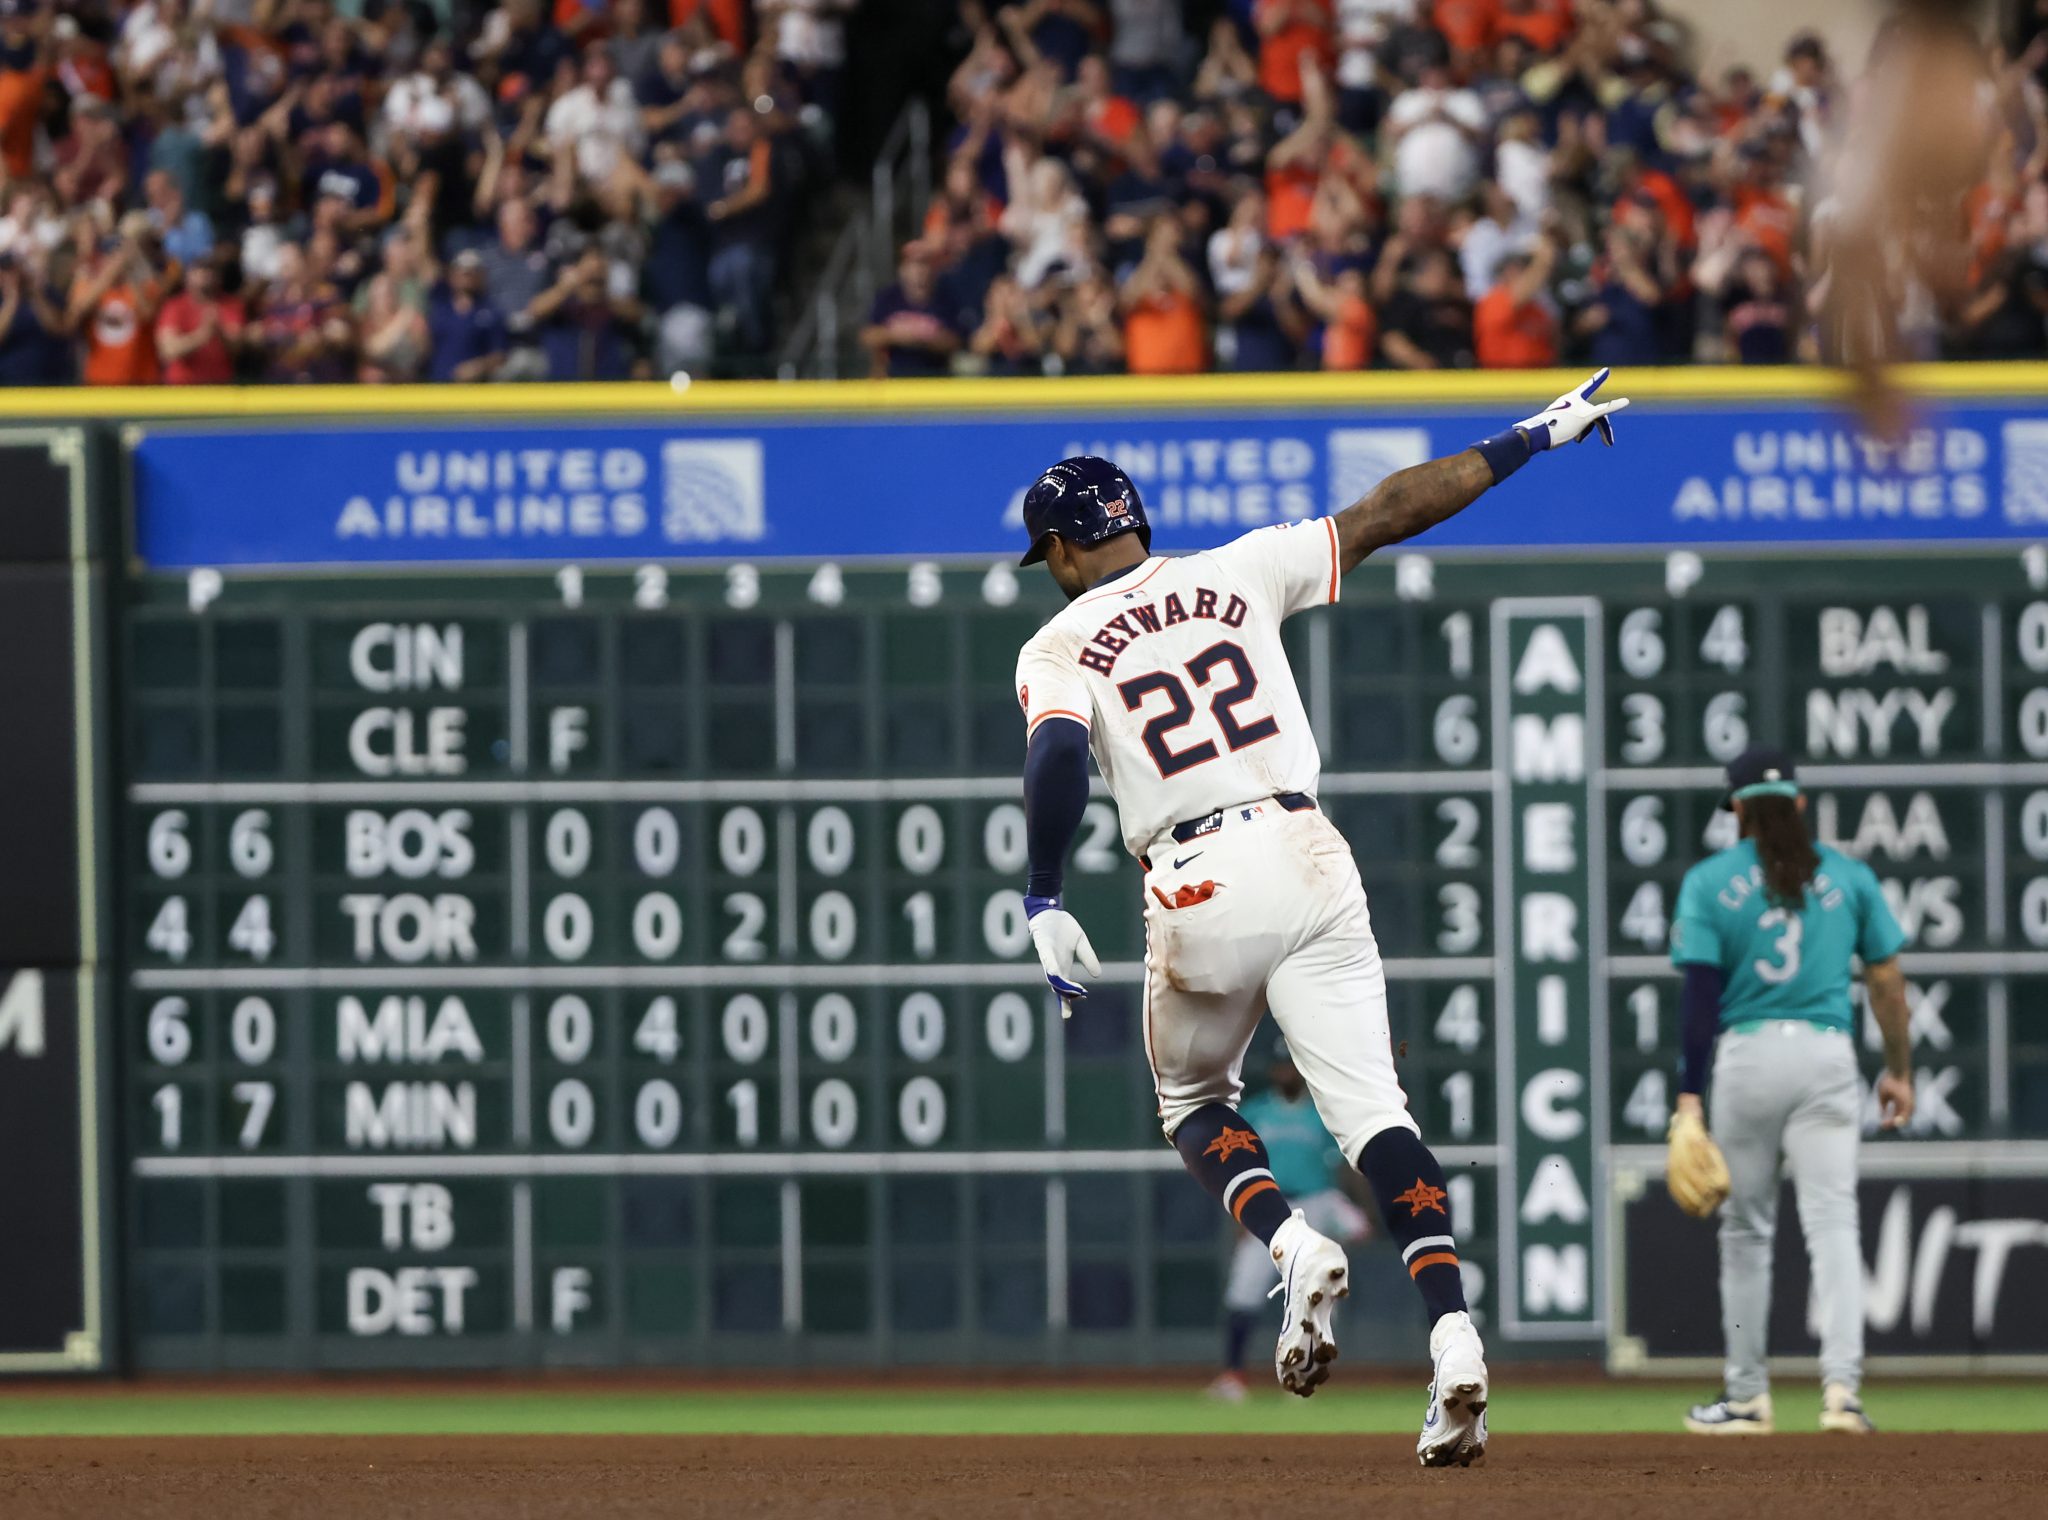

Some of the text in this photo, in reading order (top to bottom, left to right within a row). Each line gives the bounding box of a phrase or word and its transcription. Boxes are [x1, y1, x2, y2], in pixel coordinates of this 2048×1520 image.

[397, 447, 647, 494] UNITED
[1672, 475, 1987, 520] AIRLINES
[336, 494, 647, 537] AIRLINES
[1106, 499, 1128, 518] 22
[188, 553, 1434, 612] P 1 2 3 4 5 6 R
[1665, 551, 1703, 596] P
[350, 612, 1472, 691] CIN 1
[1079, 587, 1248, 678] HEYWARD
[1620, 608, 1665, 678] 6
[1702, 606, 1746, 669] 4
[1819, 607, 1946, 677] BAL
[349, 695, 1479, 775] CLE F 6
[1116, 640, 1281, 780] 22
[1623, 694, 1665, 764] 3
[1704, 692, 1748, 762] 6
[1807, 689, 1954, 758] NYY
[148, 798, 1479, 878] 6 6 BOS 0 0 0 0 0 0 2 2
[1621, 796, 1666, 866] 6
[1816, 792, 1950, 861] LAA
[148, 883, 1481, 961] 4 4 TOR 0 0 2 0 1 0 3
[1621, 881, 1666, 948] 4
[1755, 907, 1803, 982] 3
[1513, 625, 1589, 1314] AMERICAN
[148, 985, 1481, 1065] 6 0 MIA 0 4 0 0 0 0 4
[1629, 985, 1659, 1051] 1
[153, 1071, 1473, 1149] 1 7 MIN 0 0 1 0 0 1
[1624, 1070, 1668, 1138] 4
[368, 1184, 455, 1251] TB
[347, 1267, 590, 1335] DET F
